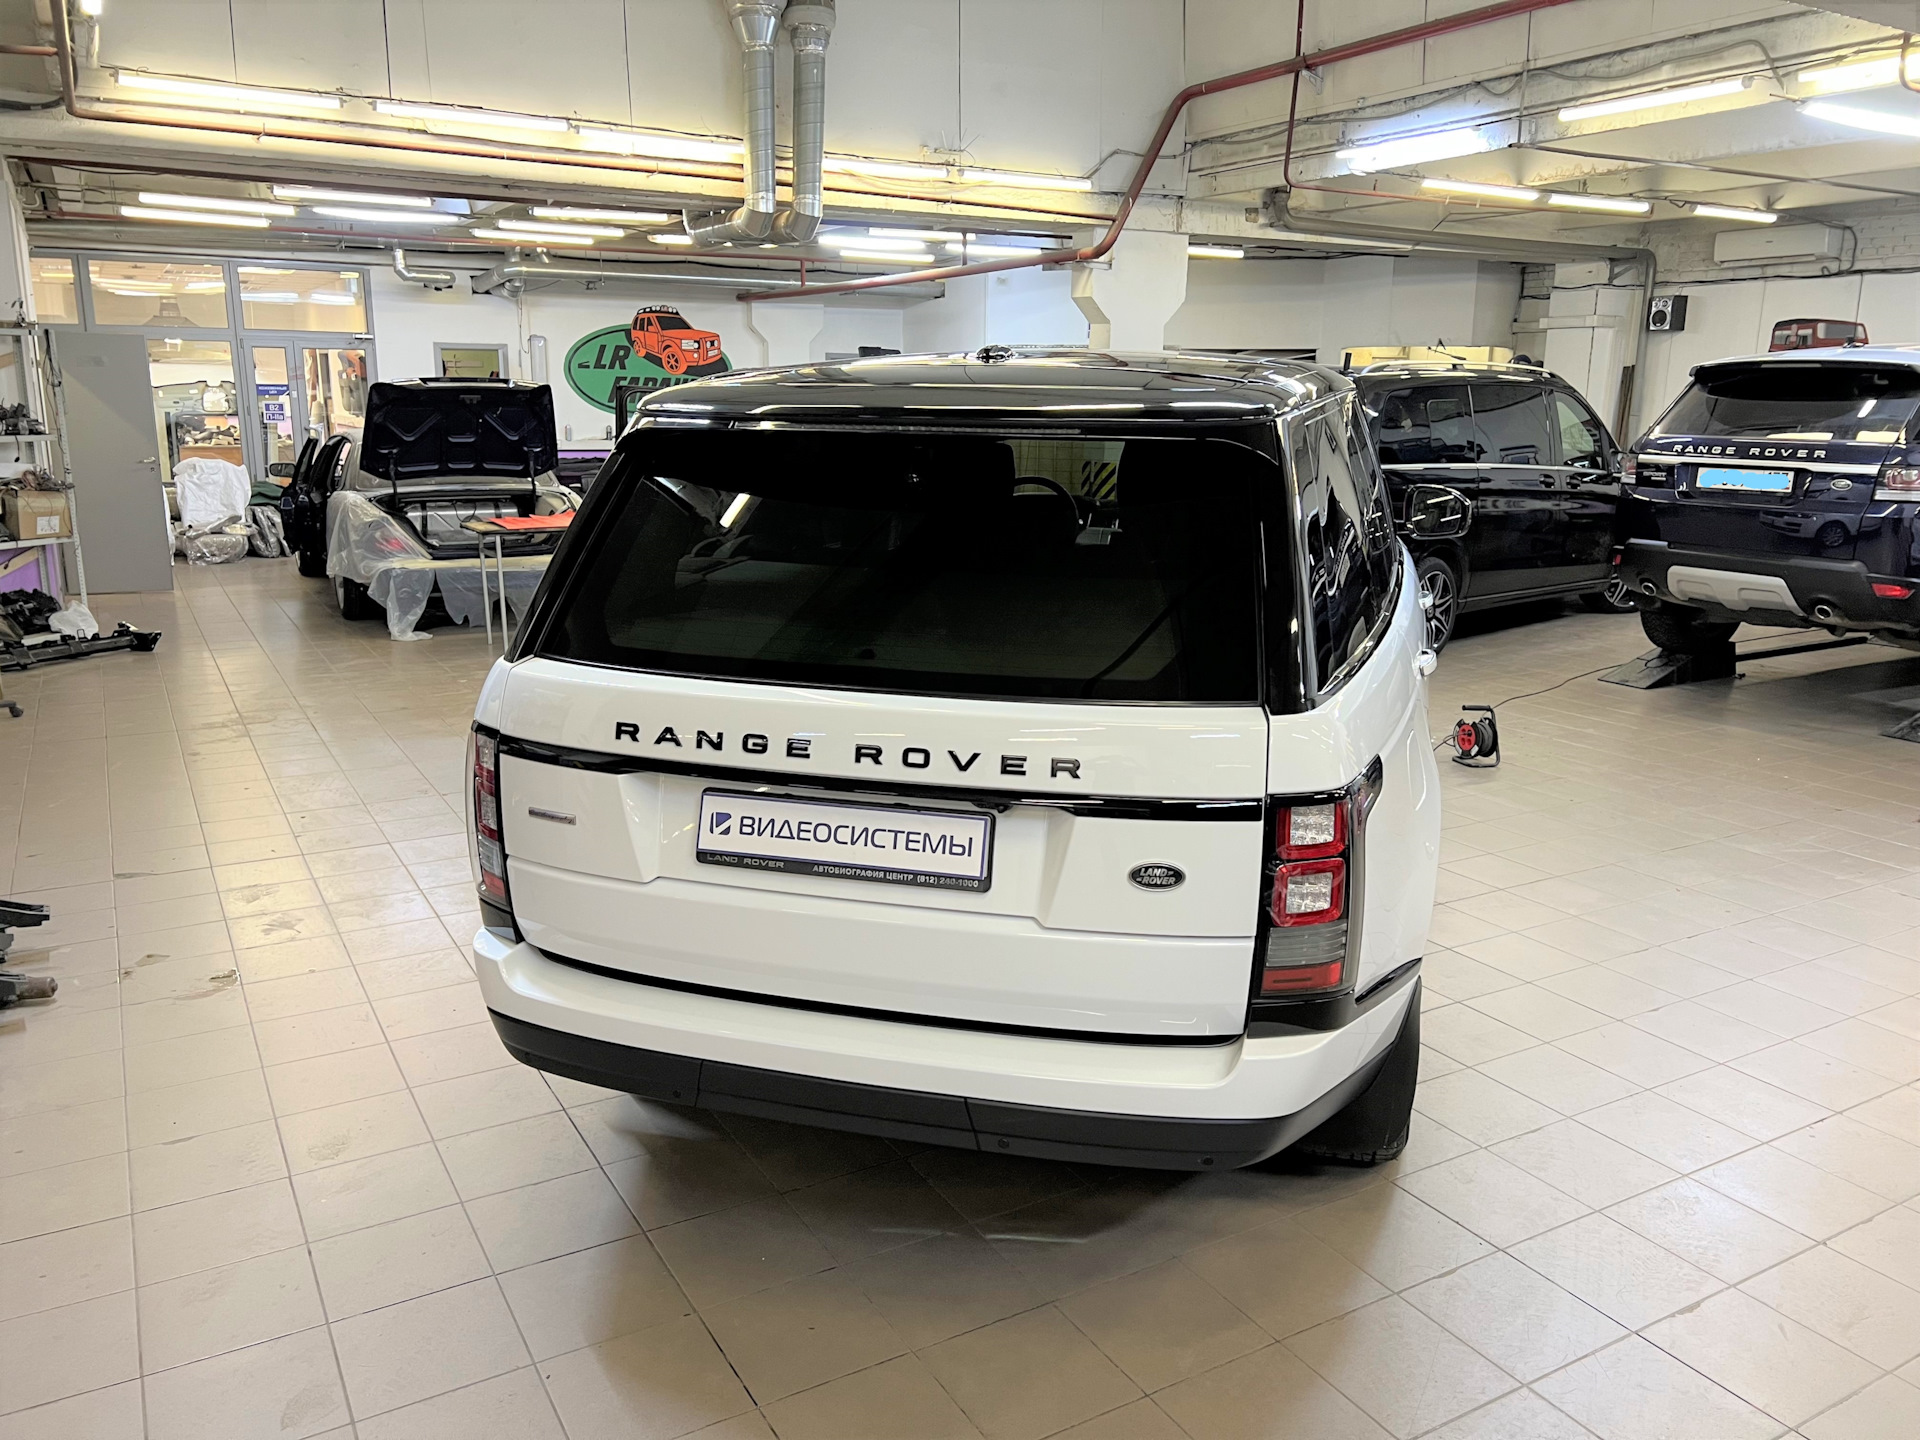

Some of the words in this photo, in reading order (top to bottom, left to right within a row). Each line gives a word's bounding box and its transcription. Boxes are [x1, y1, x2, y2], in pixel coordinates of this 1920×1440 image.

[593, 344, 631, 370] LR
[1672, 445, 1737, 455] RANGE
[1748, 447, 1827, 459] ROVER
[615, 721, 812, 759] RANGE
[854, 743, 1081, 779] ROVER
[738, 815, 974, 857] ВИДЕОСИСТЕМЫ
[706, 853, 738, 863] LAND
[743, 857, 785, 868] ROVER
[812, 864, 884, 879] АВТОБИОГРАФИЯ
[886, 872, 914, 882] ЦЕНТР
[917, 874, 938, 885] (812)
[1140, 867, 1168, 877] LAND
[1141, 876, 1176, 885] ROVER
